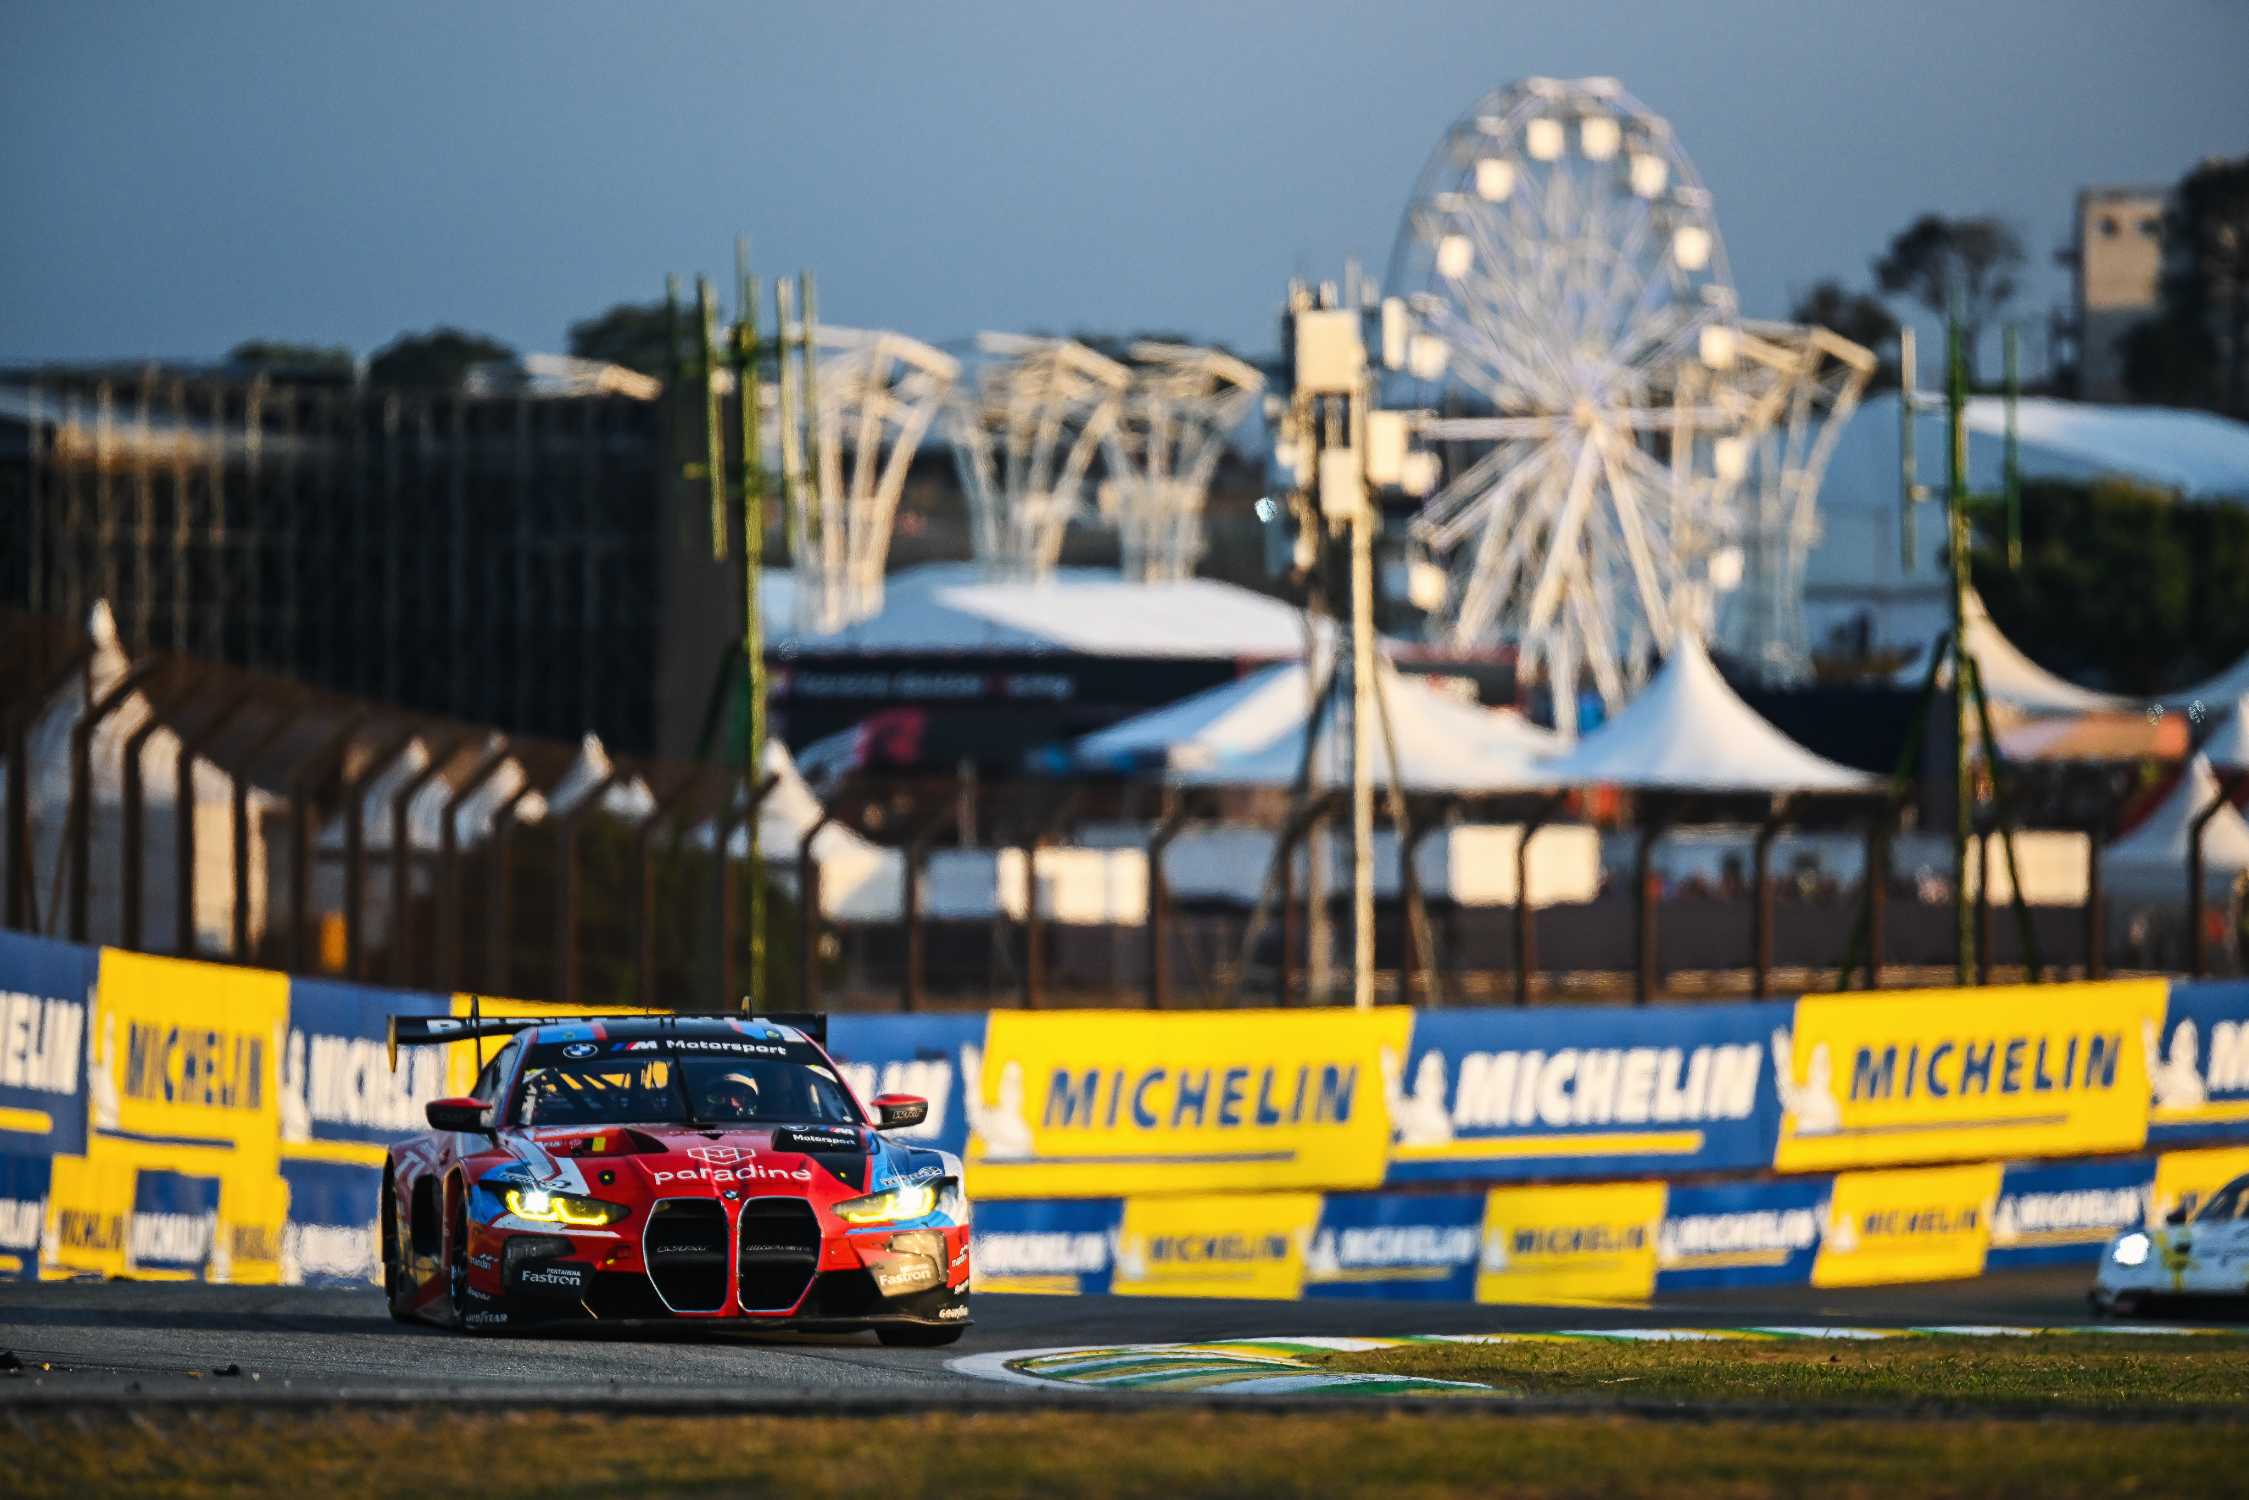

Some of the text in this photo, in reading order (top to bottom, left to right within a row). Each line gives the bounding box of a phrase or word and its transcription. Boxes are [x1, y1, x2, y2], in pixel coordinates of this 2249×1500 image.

[666, 1039, 786, 1056] Motorsport
[126, 1023, 262, 1109] MICHELIN
[1851, 1034, 2121, 1101] MICHELIN
[1044, 1064, 1357, 1129] MICHELIN
[1455, 1042, 1763, 1127] MICHELIN
[792, 1133, 856, 1146] Motorsport
[654, 1164, 811, 1186] paradine
[1863, 1207, 1977, 1236] MICHELIN
[1148, 1233, 1289, 1264] MICHELIN
[1515, 1227, 1644, 1255] MICHELIN
[521, 1270, 581, 1287] Fastron
[880, 1267, 931, 1287] Fastron
